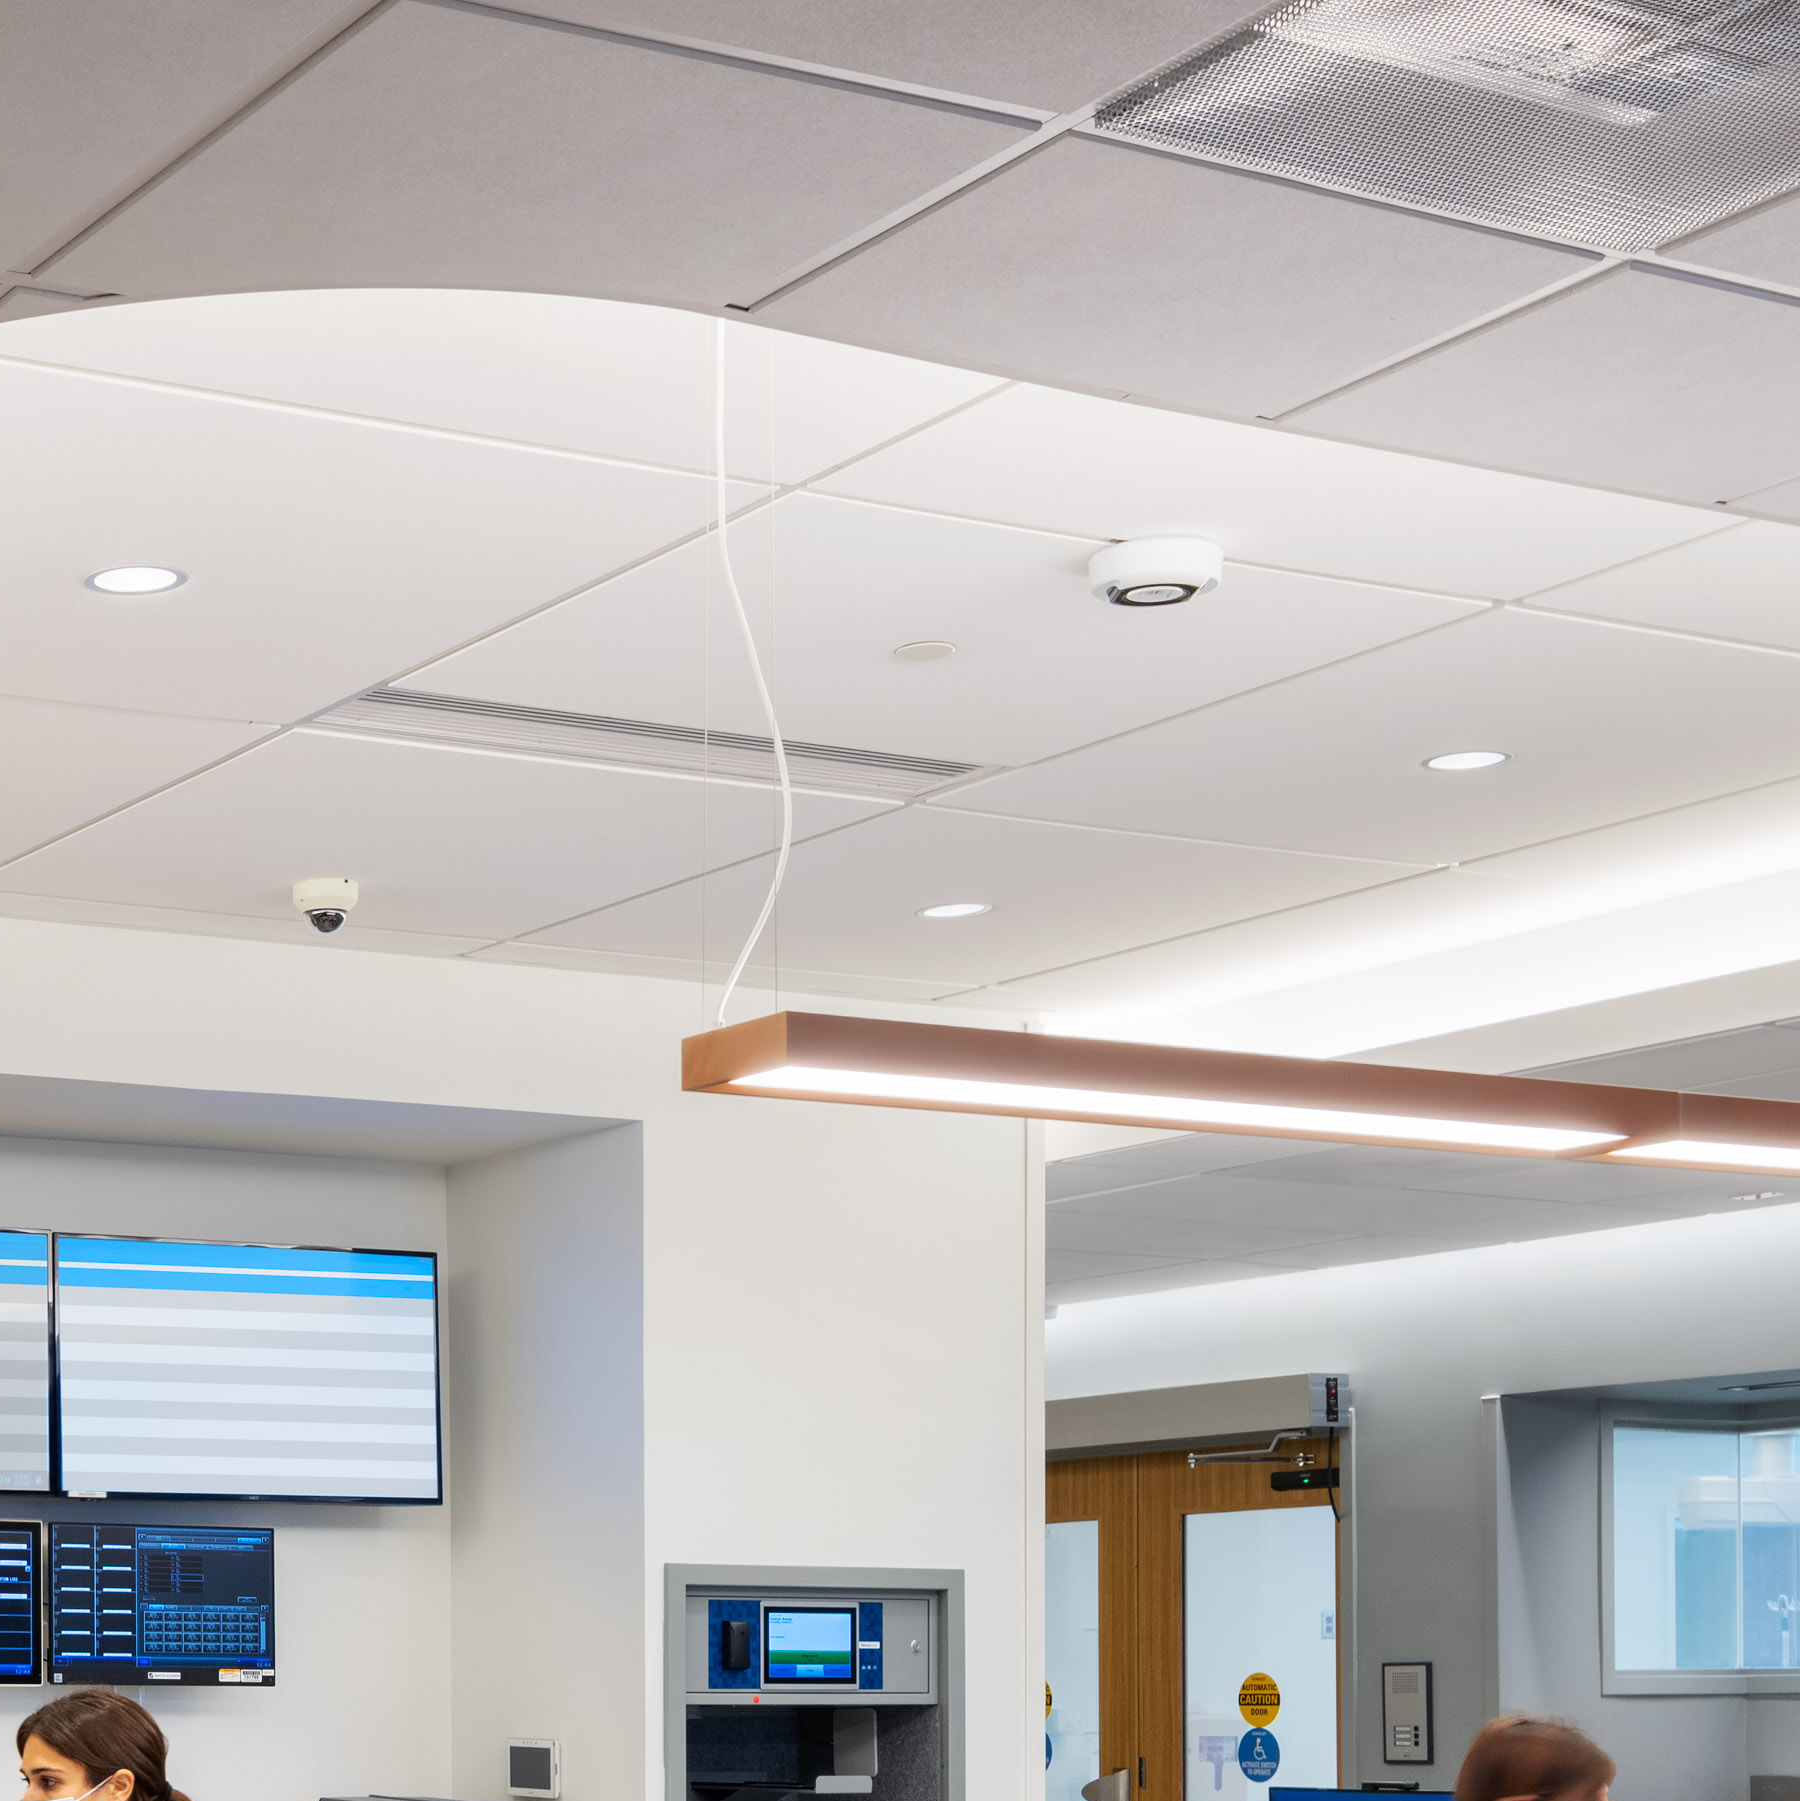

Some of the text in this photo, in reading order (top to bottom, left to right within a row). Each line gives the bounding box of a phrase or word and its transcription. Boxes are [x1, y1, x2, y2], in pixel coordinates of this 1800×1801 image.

[1241, 1683, 1277, 1691] AUTOMATIC
[1240, 1694, 1278, 1705] CAUTION
[1251, 1708, 1268, 1716] DOOR
